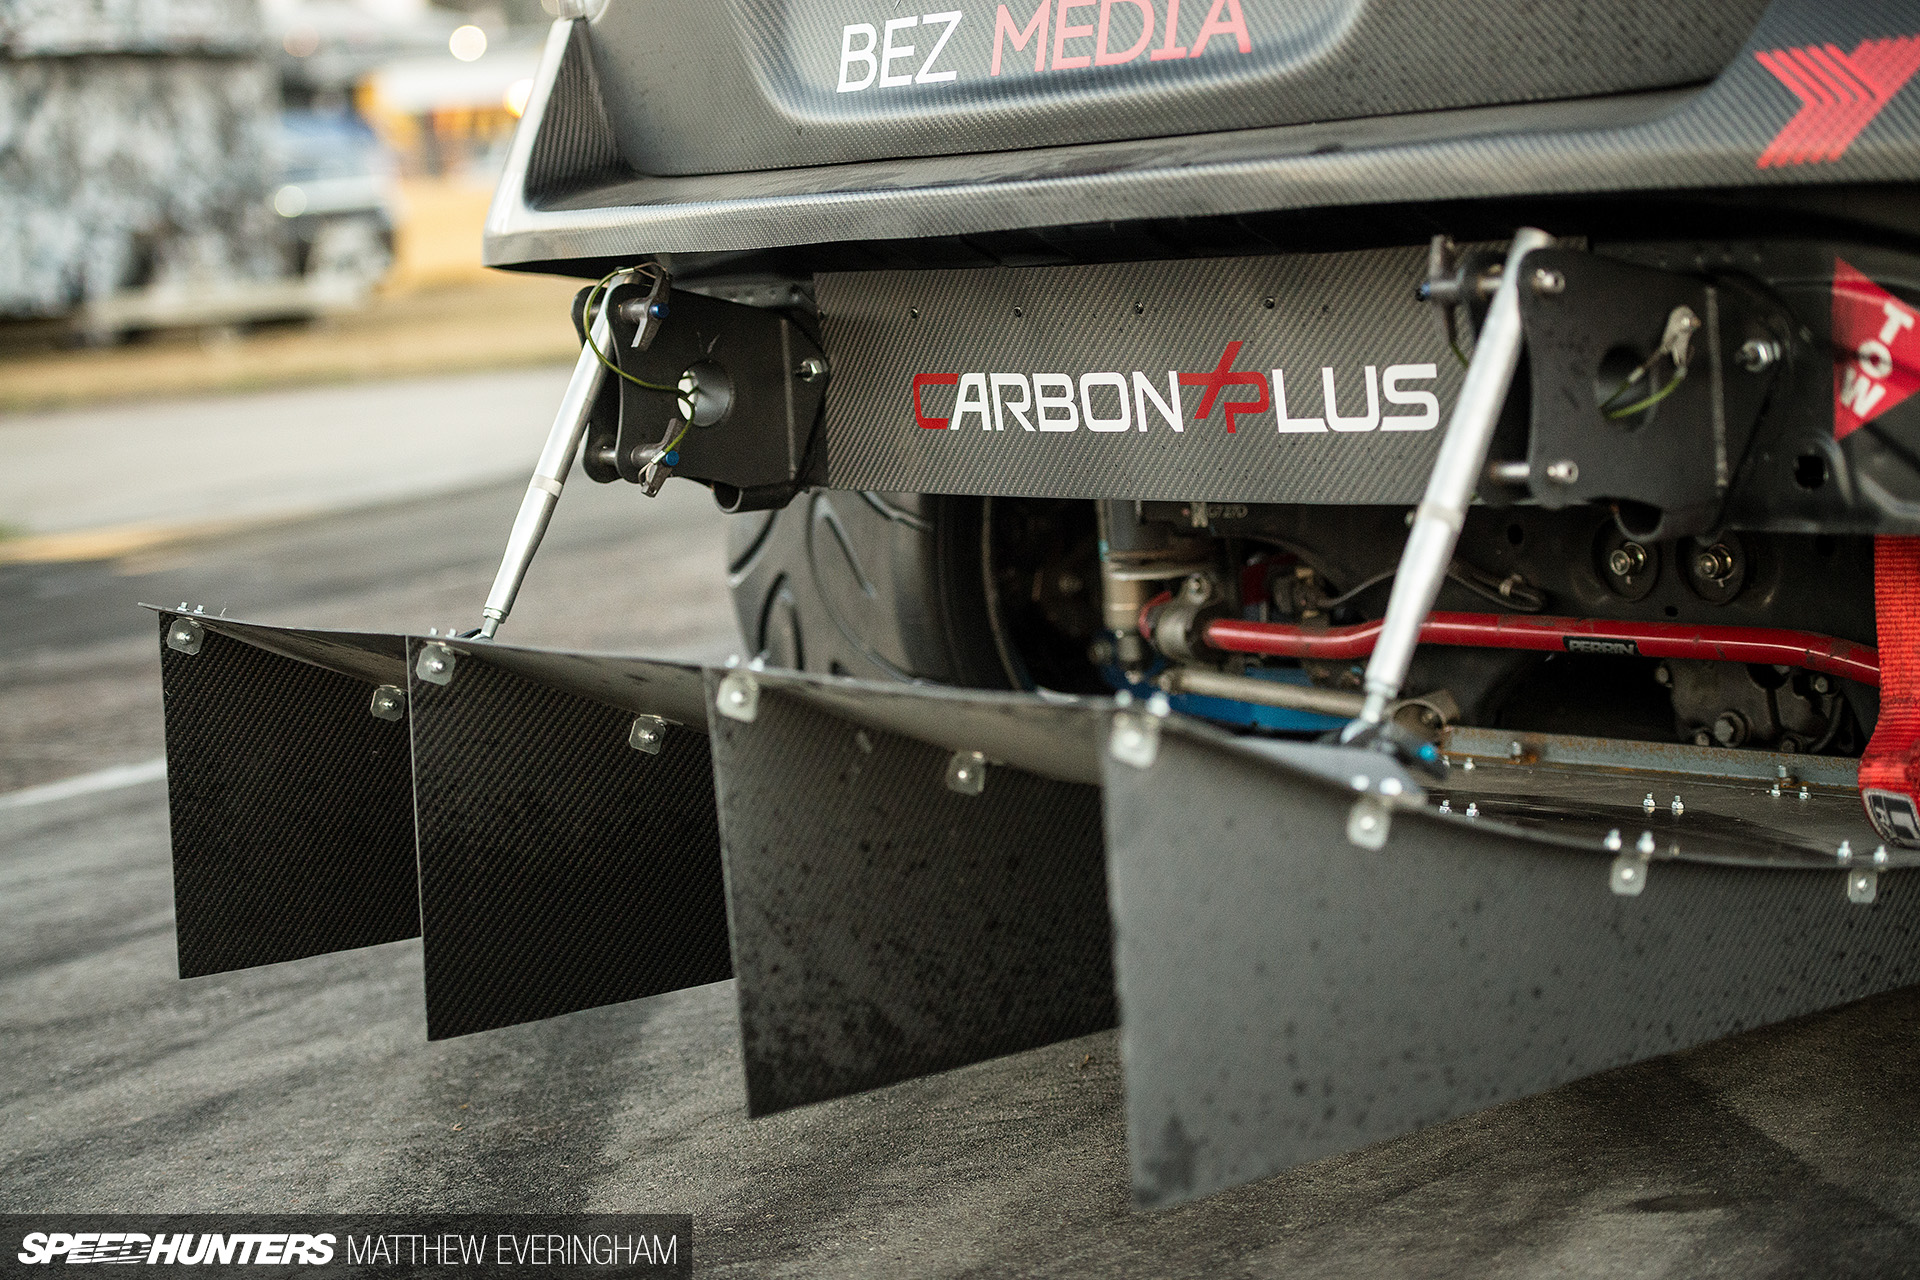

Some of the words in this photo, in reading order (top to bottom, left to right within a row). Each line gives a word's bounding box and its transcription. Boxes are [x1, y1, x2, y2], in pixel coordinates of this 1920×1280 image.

[836, 10, 962, 93] BEZ
[990, 0, 1252, 76] MEDIA
[1841, 302, 1915, 418] TOW
